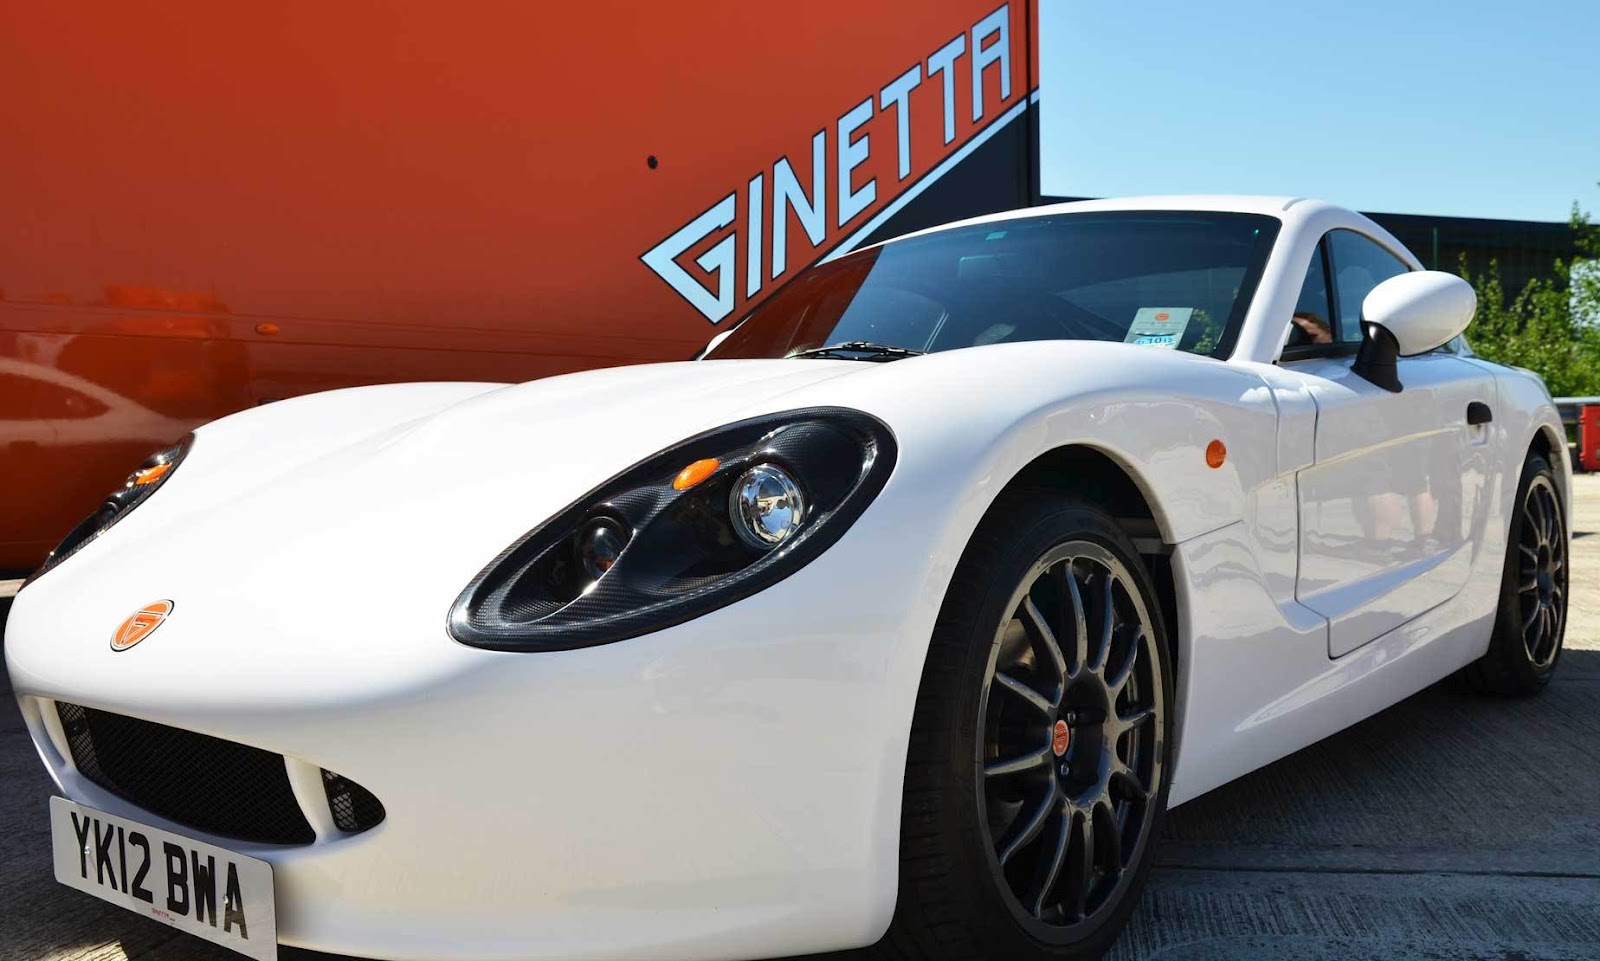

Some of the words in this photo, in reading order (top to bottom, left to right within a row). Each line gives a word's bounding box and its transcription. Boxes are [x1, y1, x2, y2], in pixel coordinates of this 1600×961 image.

[639, 3, 1011, 325] GINETTA
[70, 811, 153, 904] YK12
[163, 841, 249, 940] BWA
